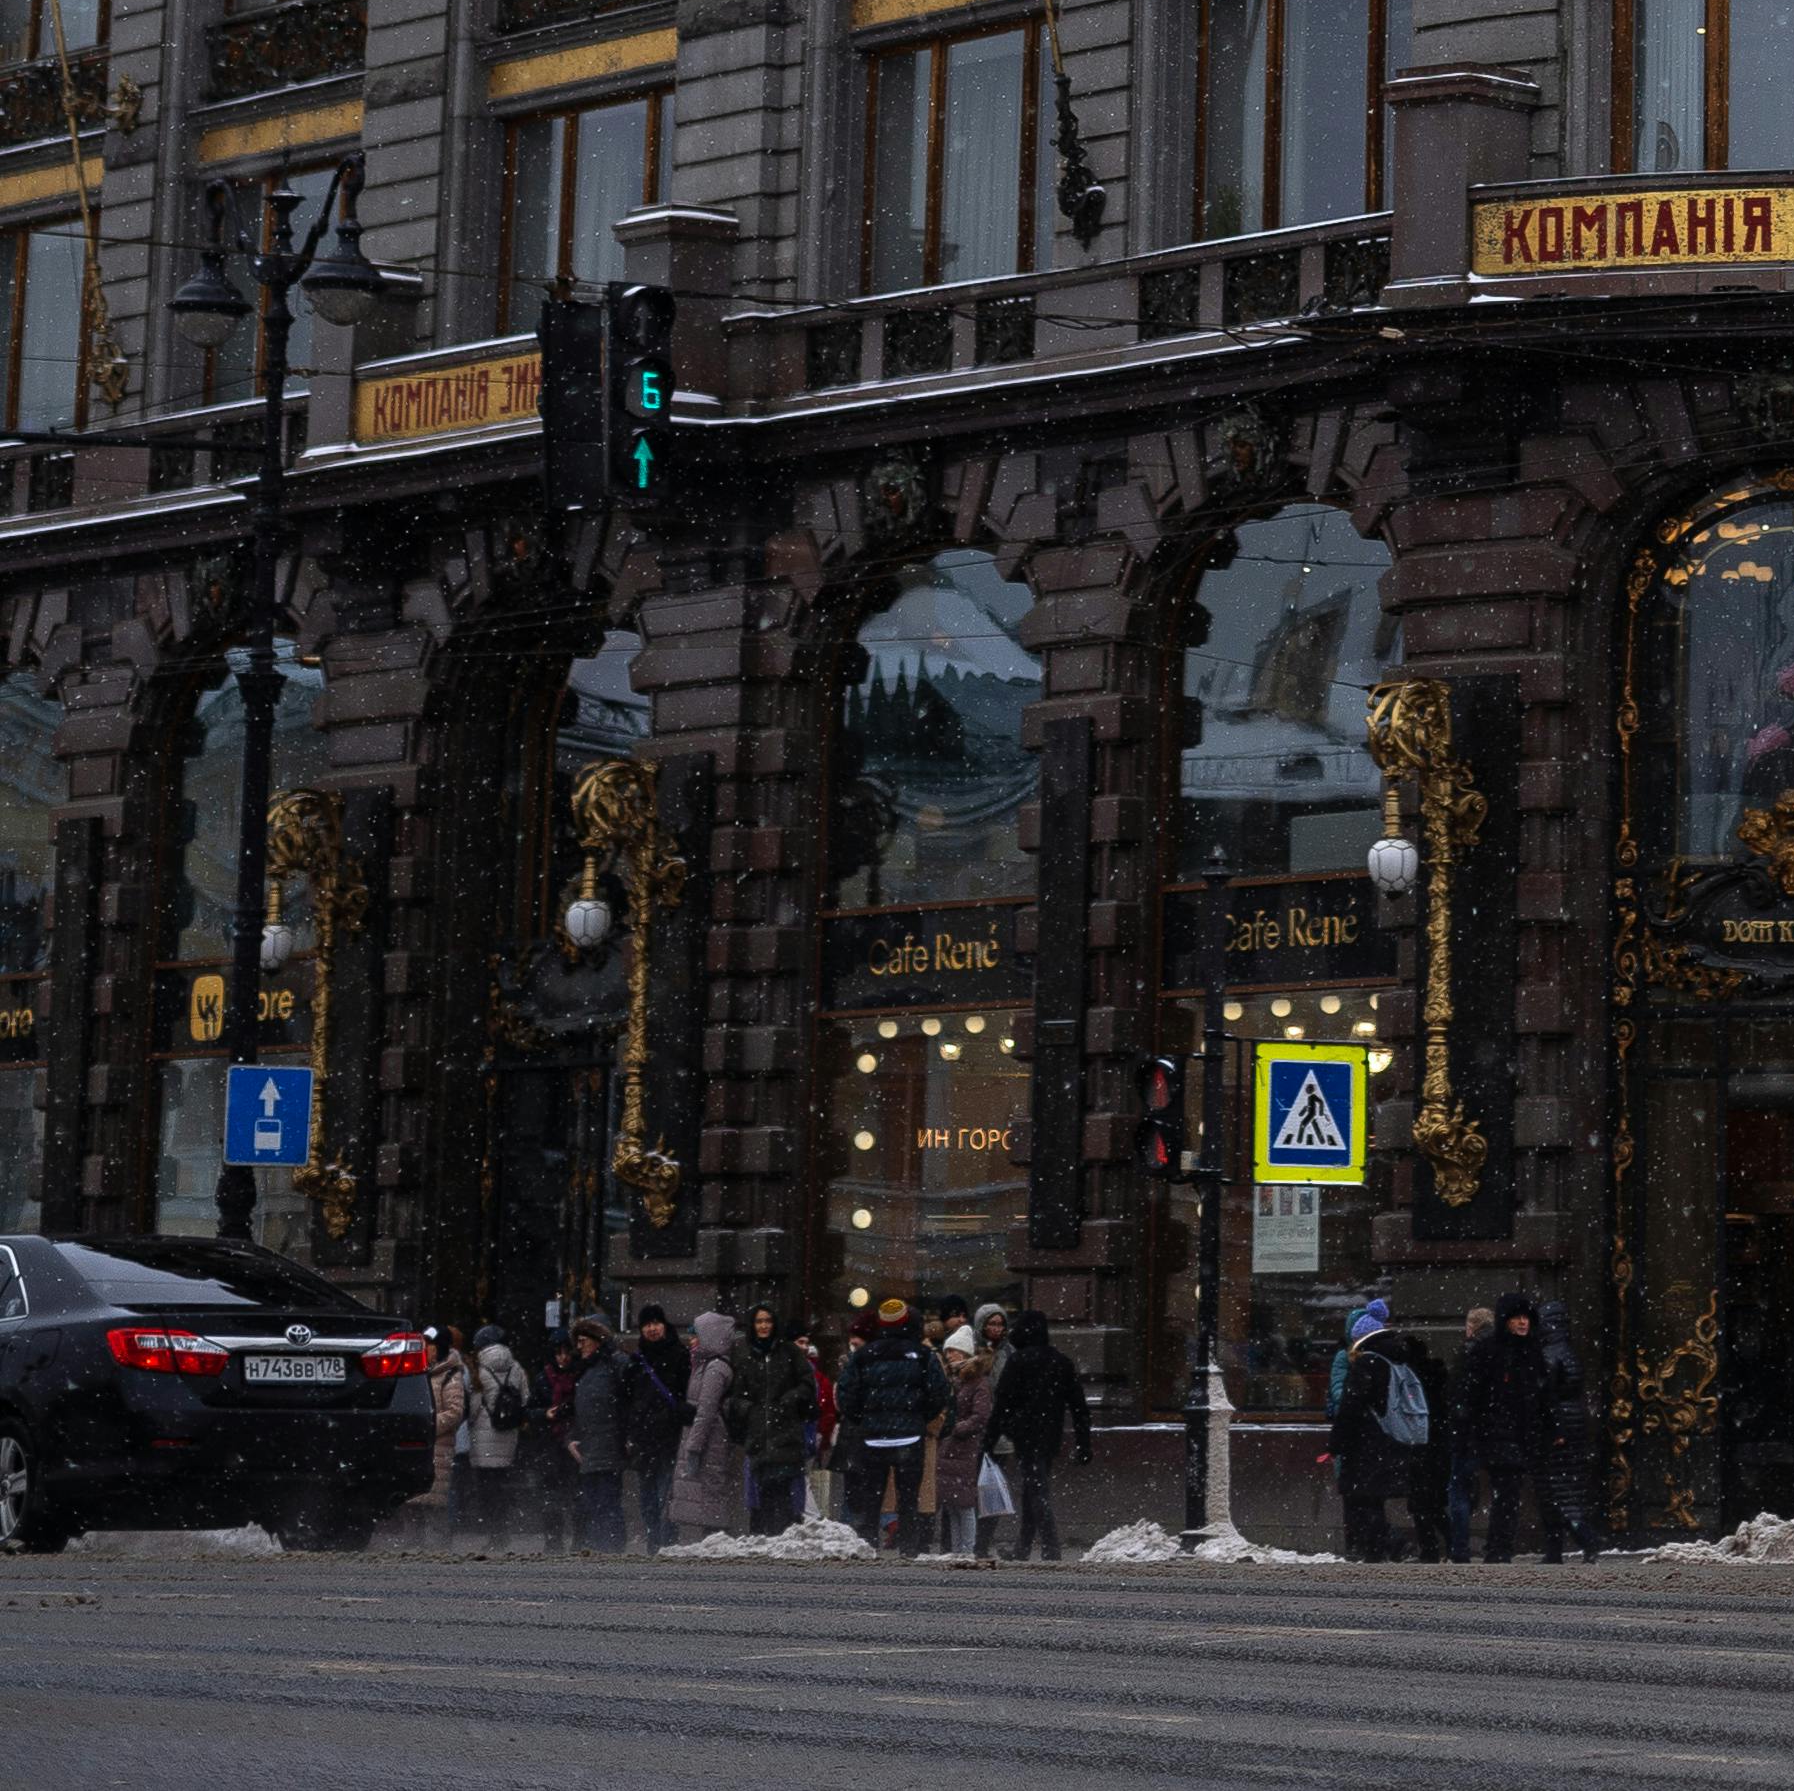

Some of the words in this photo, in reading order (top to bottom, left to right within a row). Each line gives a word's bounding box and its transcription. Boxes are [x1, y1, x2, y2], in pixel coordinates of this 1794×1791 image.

[1502, 195, 1772, 265] КОМПАНІЯ
[373, 367, 490, 435] КОМПАНІЯ
[500, 361, 543, 415] ЗИН
[642, 371, 661, 409] 6
[869, 932, 929, 976] Cafe
[935, 920, 1000, 971] René
[1287, 898, 1360, 947] René
